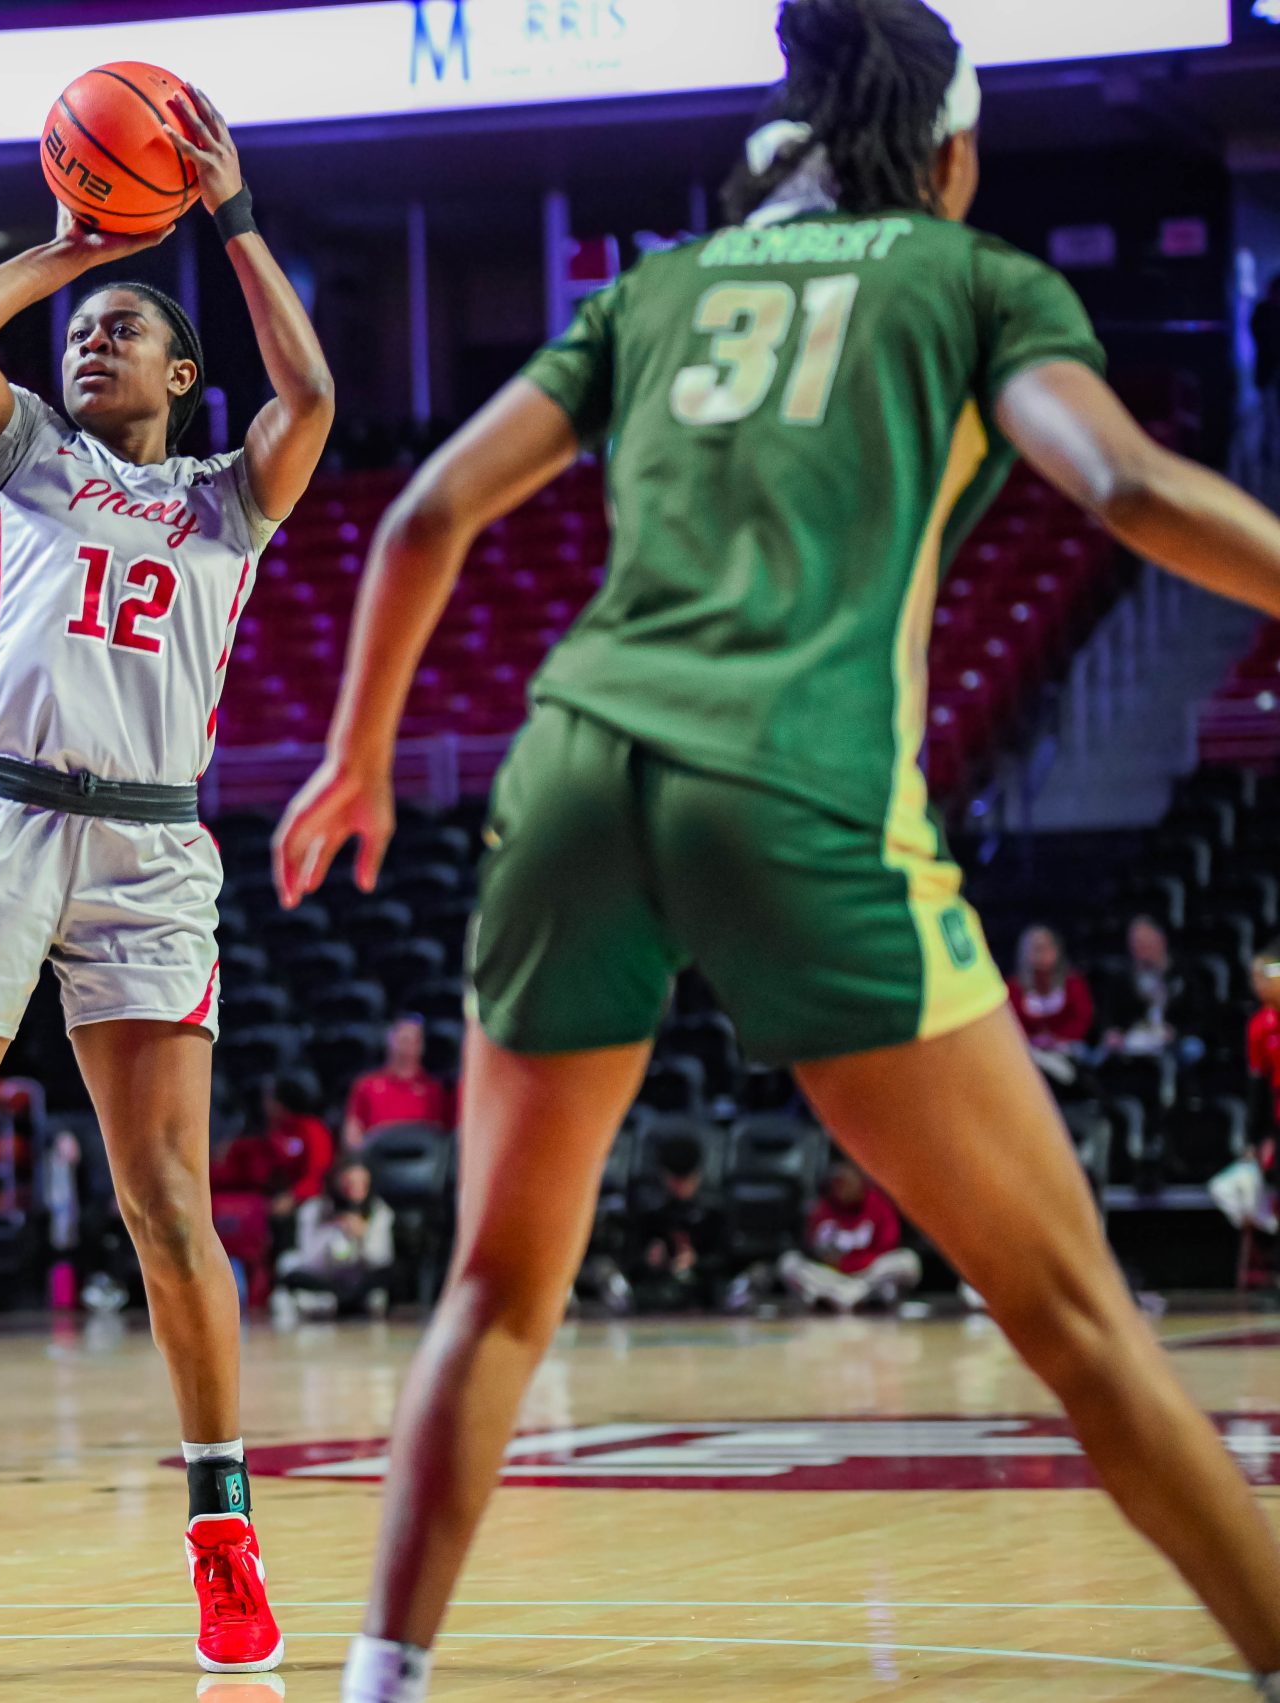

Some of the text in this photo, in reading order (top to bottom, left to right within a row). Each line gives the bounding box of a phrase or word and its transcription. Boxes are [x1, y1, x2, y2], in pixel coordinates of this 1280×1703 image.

[45, 127, 113, 202] ELITE
[671, 273, 859, 426] 31
[64, 541, 181, 658] 12
